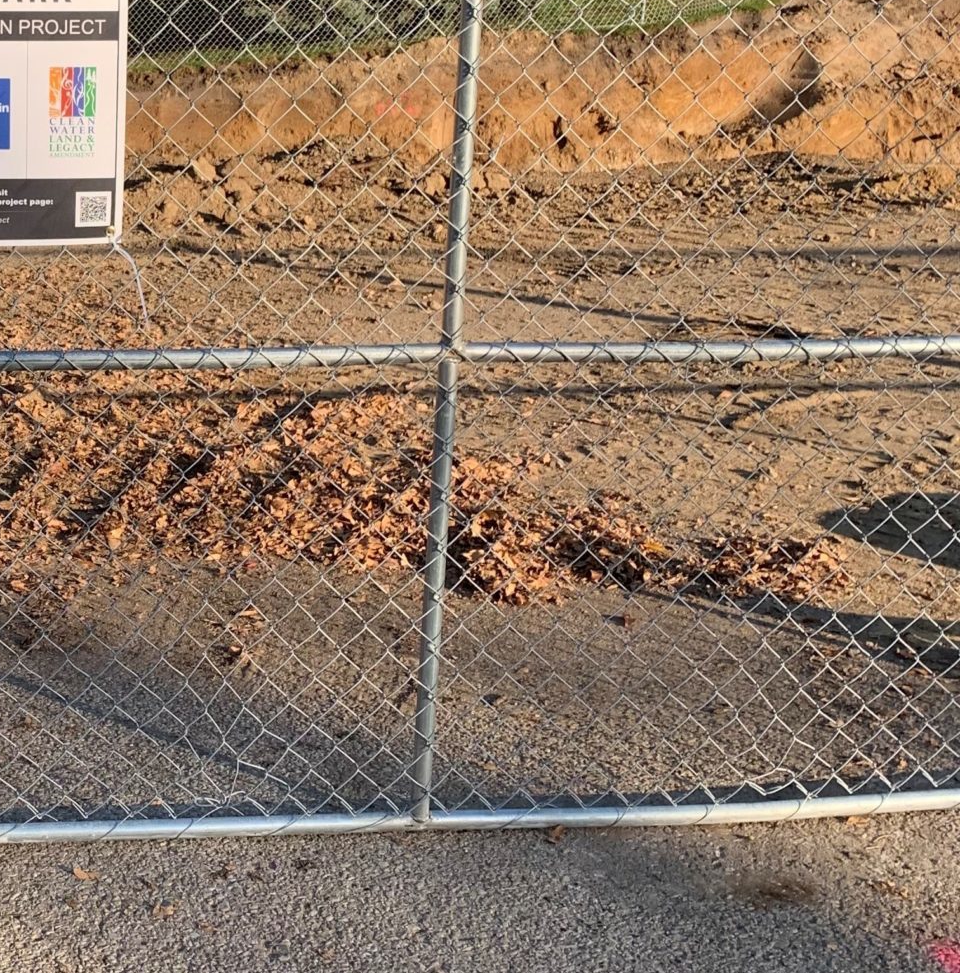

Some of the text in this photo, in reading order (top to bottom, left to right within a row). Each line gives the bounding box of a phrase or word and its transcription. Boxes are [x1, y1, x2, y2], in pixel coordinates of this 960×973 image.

[18, 19, 106, 35] PROJECT
[49, 117, 95, 125] CLEAN
[49, 126, 95, 134] WATER
[49, 135, 94, 143] LAND &
